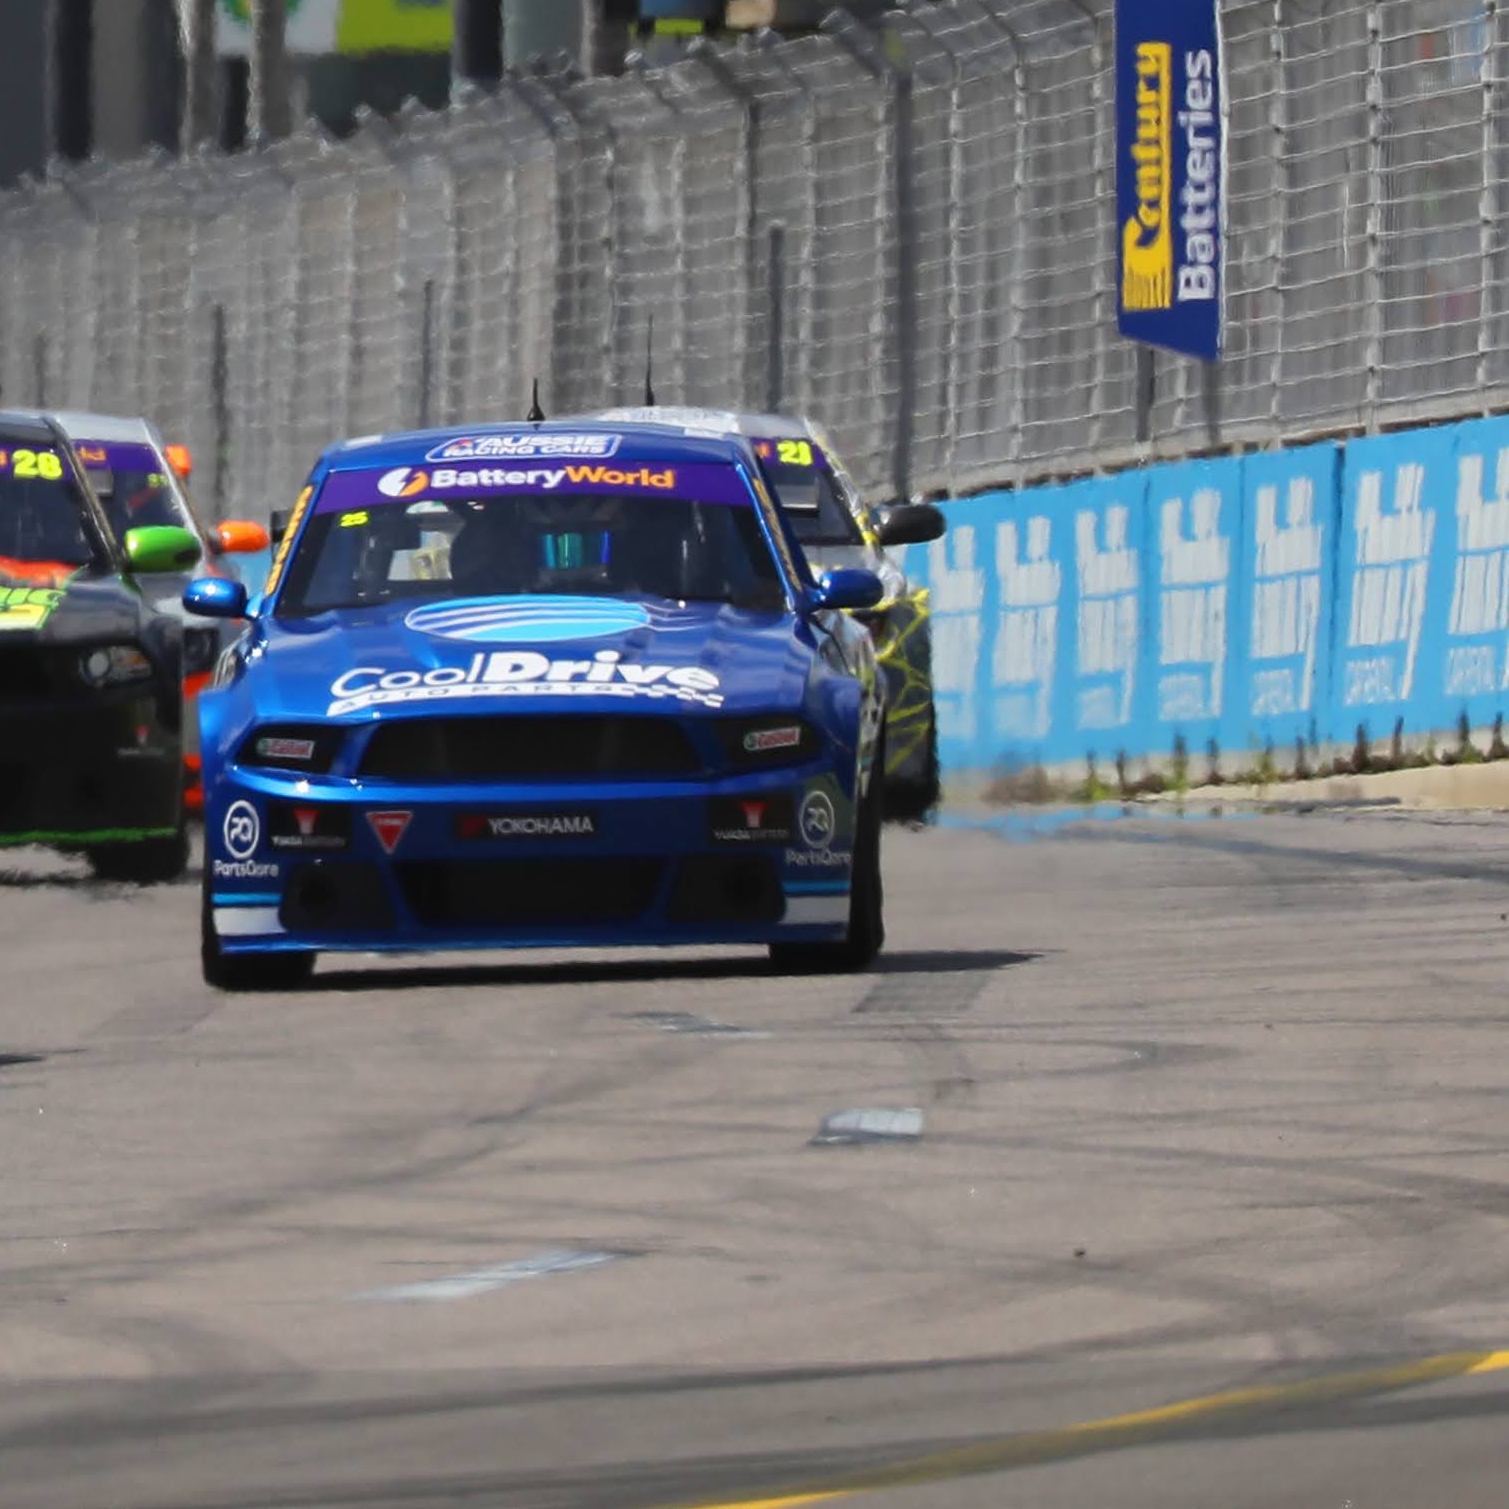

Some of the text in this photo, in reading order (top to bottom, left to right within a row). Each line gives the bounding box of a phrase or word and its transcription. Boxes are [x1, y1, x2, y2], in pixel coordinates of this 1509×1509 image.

[1177, 48, 1216, 302] Batteries
[429, 465, 676, 491] BatteryWorld
[331, 649, 721, 699] CoolDrive
[486, 816, 594, 835] YOKOHAMA
